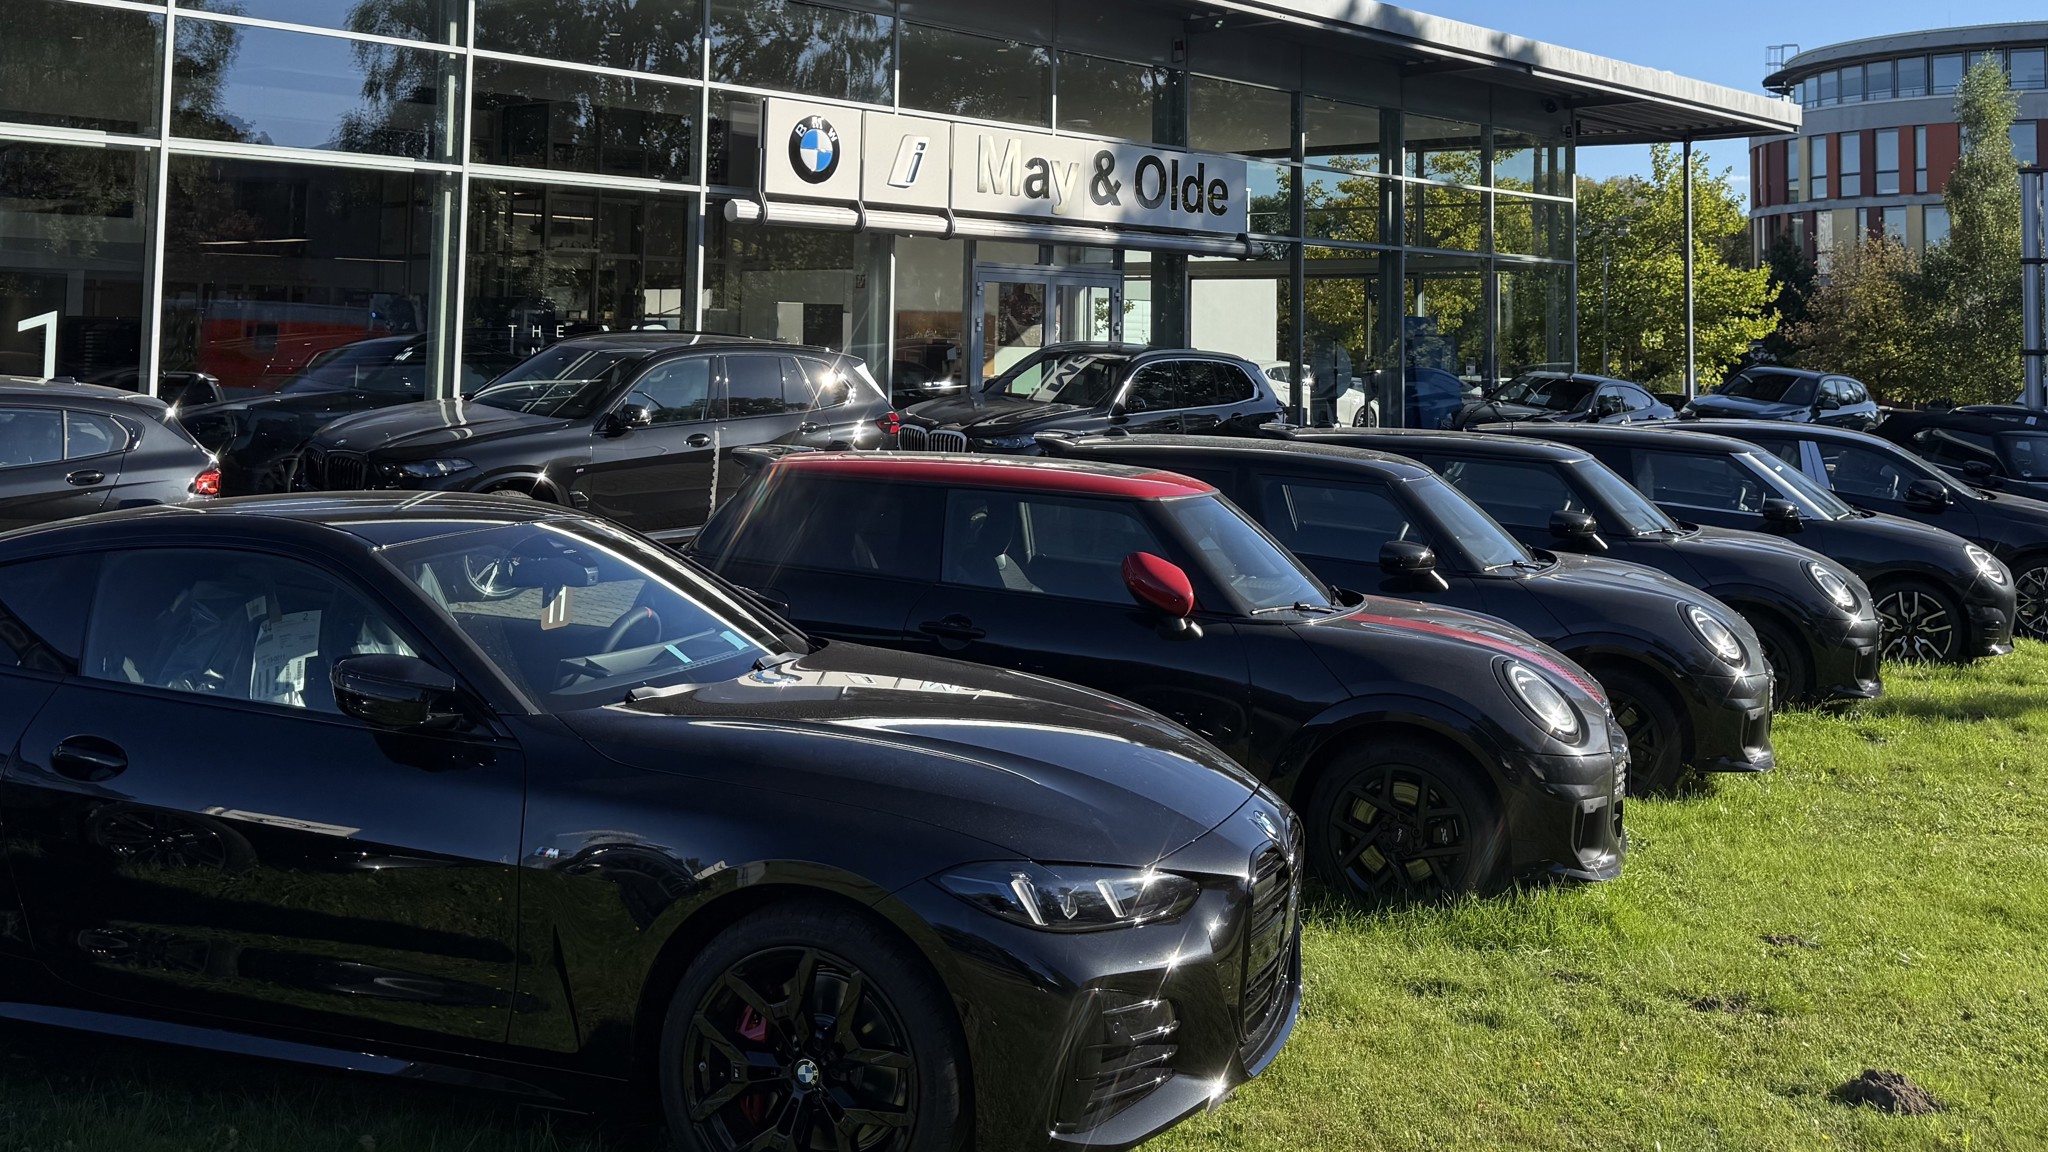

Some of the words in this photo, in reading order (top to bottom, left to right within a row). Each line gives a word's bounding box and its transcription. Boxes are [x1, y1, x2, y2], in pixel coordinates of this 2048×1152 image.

[977, 134, 1080, 215] May
[1089, 149, 1122, 206] &
[1134, 154, 1229, 216] Olde
[17, 310, 58, 380] 1
[508, 324, 565, 338] THE
